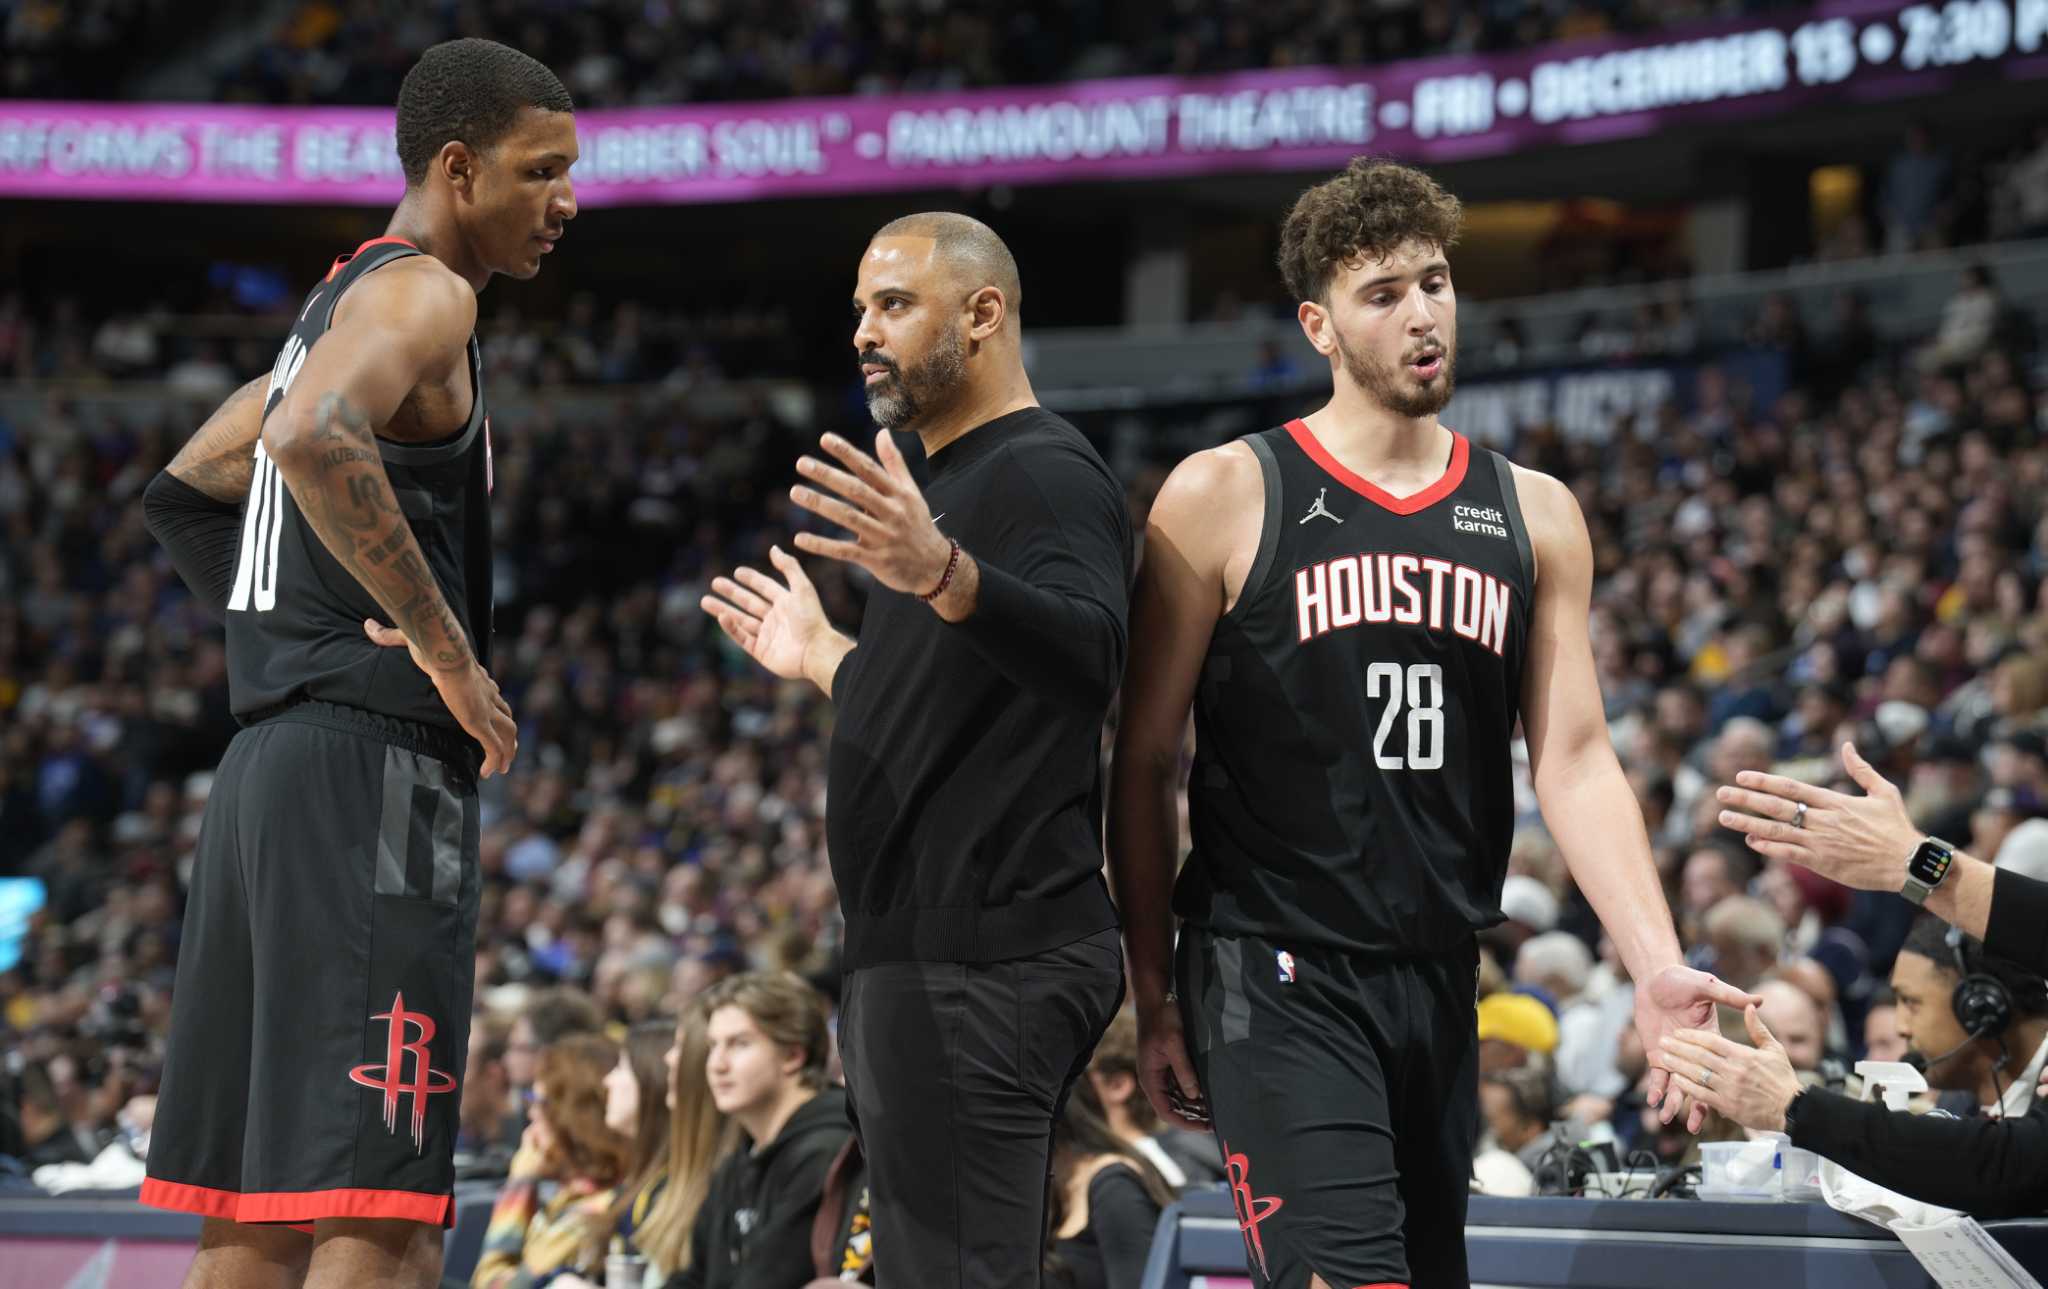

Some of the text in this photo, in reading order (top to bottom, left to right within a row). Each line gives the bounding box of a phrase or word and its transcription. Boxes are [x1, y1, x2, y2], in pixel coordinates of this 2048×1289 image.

[568, 122, 707, 184] UBBER
[887, 97, 1168, 168] PARAMOUNT
[1177, 76, 1376, 152] THEATRE
[1413, 71, 1495, 138] FRI
[1530, 28, 1787, 123] DECEMBER
[1453, 517, 1507, 538] karma
[1454, 503, 1504, 524] credit
[1295, 552, 1511, 657] HOUSTON
[1367, 662, 1445, 770] 28
